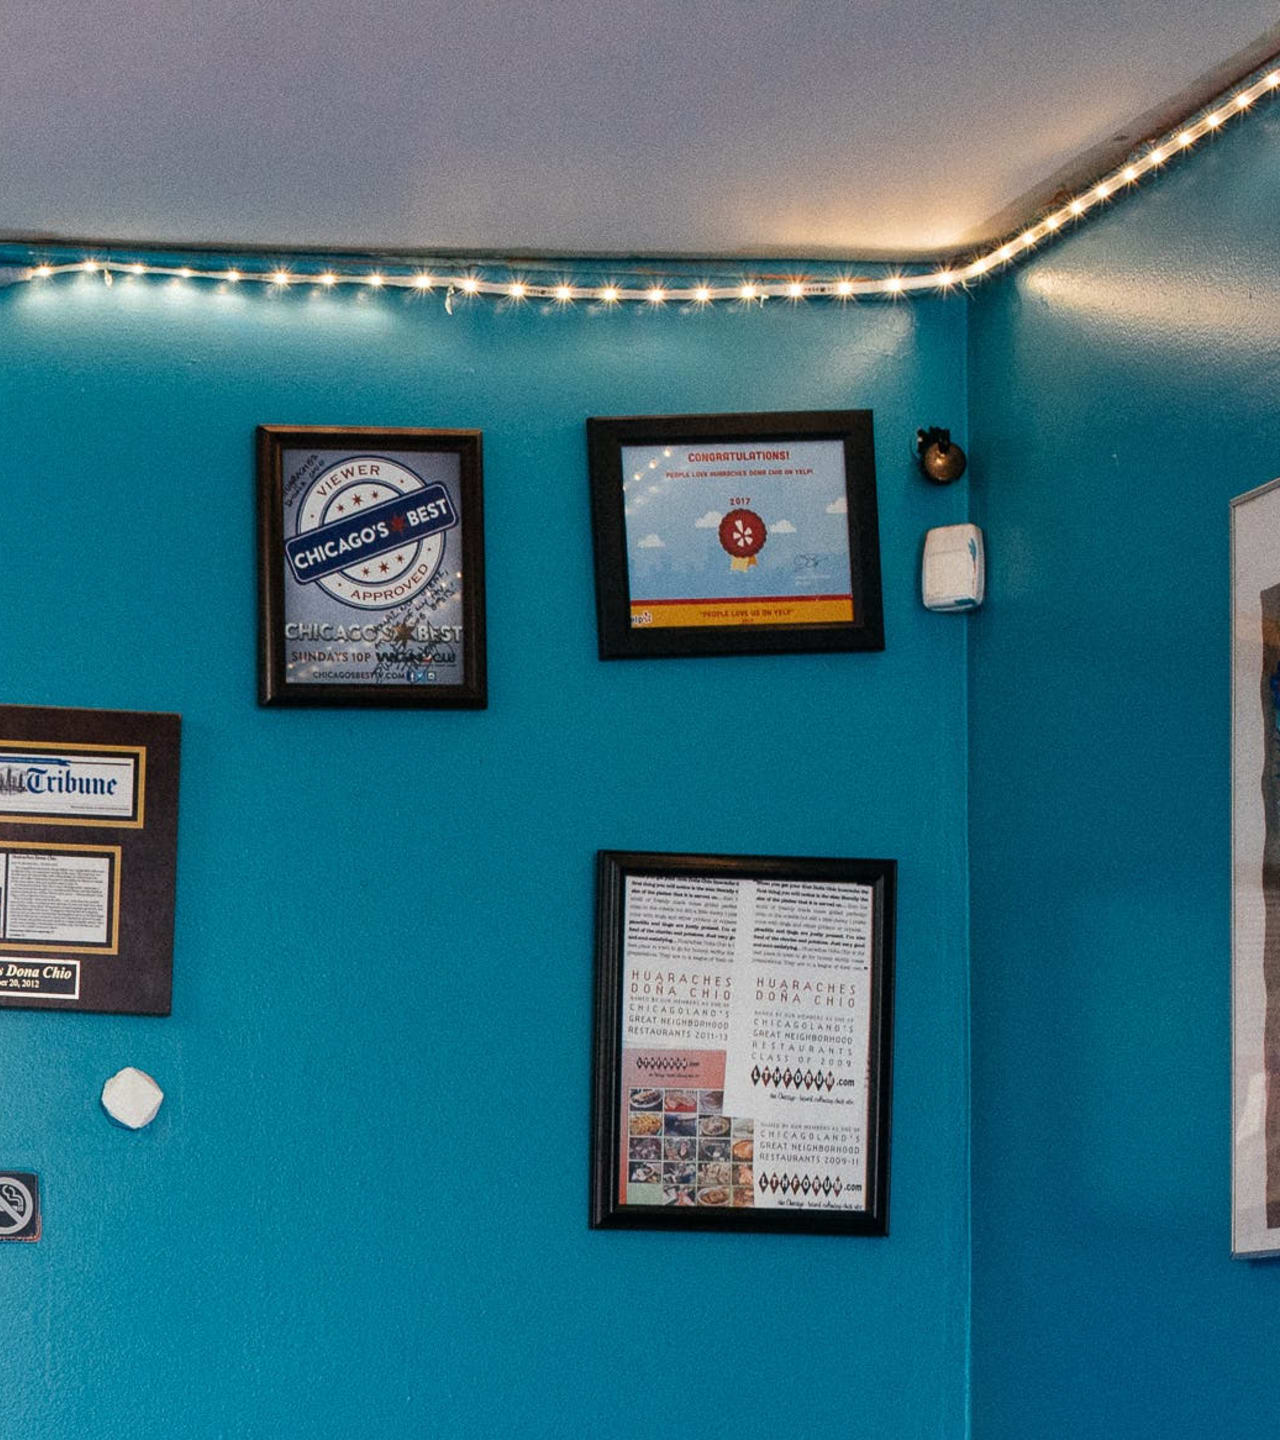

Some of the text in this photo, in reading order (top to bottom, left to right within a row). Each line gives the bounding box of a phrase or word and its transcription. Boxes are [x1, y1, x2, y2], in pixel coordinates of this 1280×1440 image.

[688, 451, 790, 463] CONGRATULATIONS!
[317, 465, 380, 496] VIEWER
[730, 498, 751, 506] 2017
[295, 499, 448, 569] CHICAGO'S BEST
[351, 563, 428, 601] APPROVED
[292, 652, 349, 662] SUNDAYS
[26, 767, 117, 795] Tribune
[6, 964, 40, 978] Dona
[42, 966, 72, 980] Chio
[631, 970, 732, 987] HUARACHES
[22, 979, 40, 988] 2012
[631, 981, 731, 1001] DOÑA CHIO
[756, 977, 856, 995] HUARACHES
[756, 989, 855, 1008] DOÑA CHIO
[629, 1003, 730, 1018] CHICAGOLAND'S
[629, 1015, 729, 1030] GREAT NEIGHBORHOOD
[753, 1018, 854, 1033] CHICAGOLAND'S
[628, 1026, 691, 1038] RESTAURANTS
[753, 1029, 853, 1045] GREAT NEIGHBORHOOD
[752, 1041, 852, 1056] RESTAURANTS
[751, 1052, 852, 1067] CLASS OF 2009
[760, 1130, 860, 1143] CHICAGOLAND'S
[760, 1141, 860, 1155] GREAT NEIGHBORHOOD
[760, 1153, 820, 1163] RESTAURANTS
